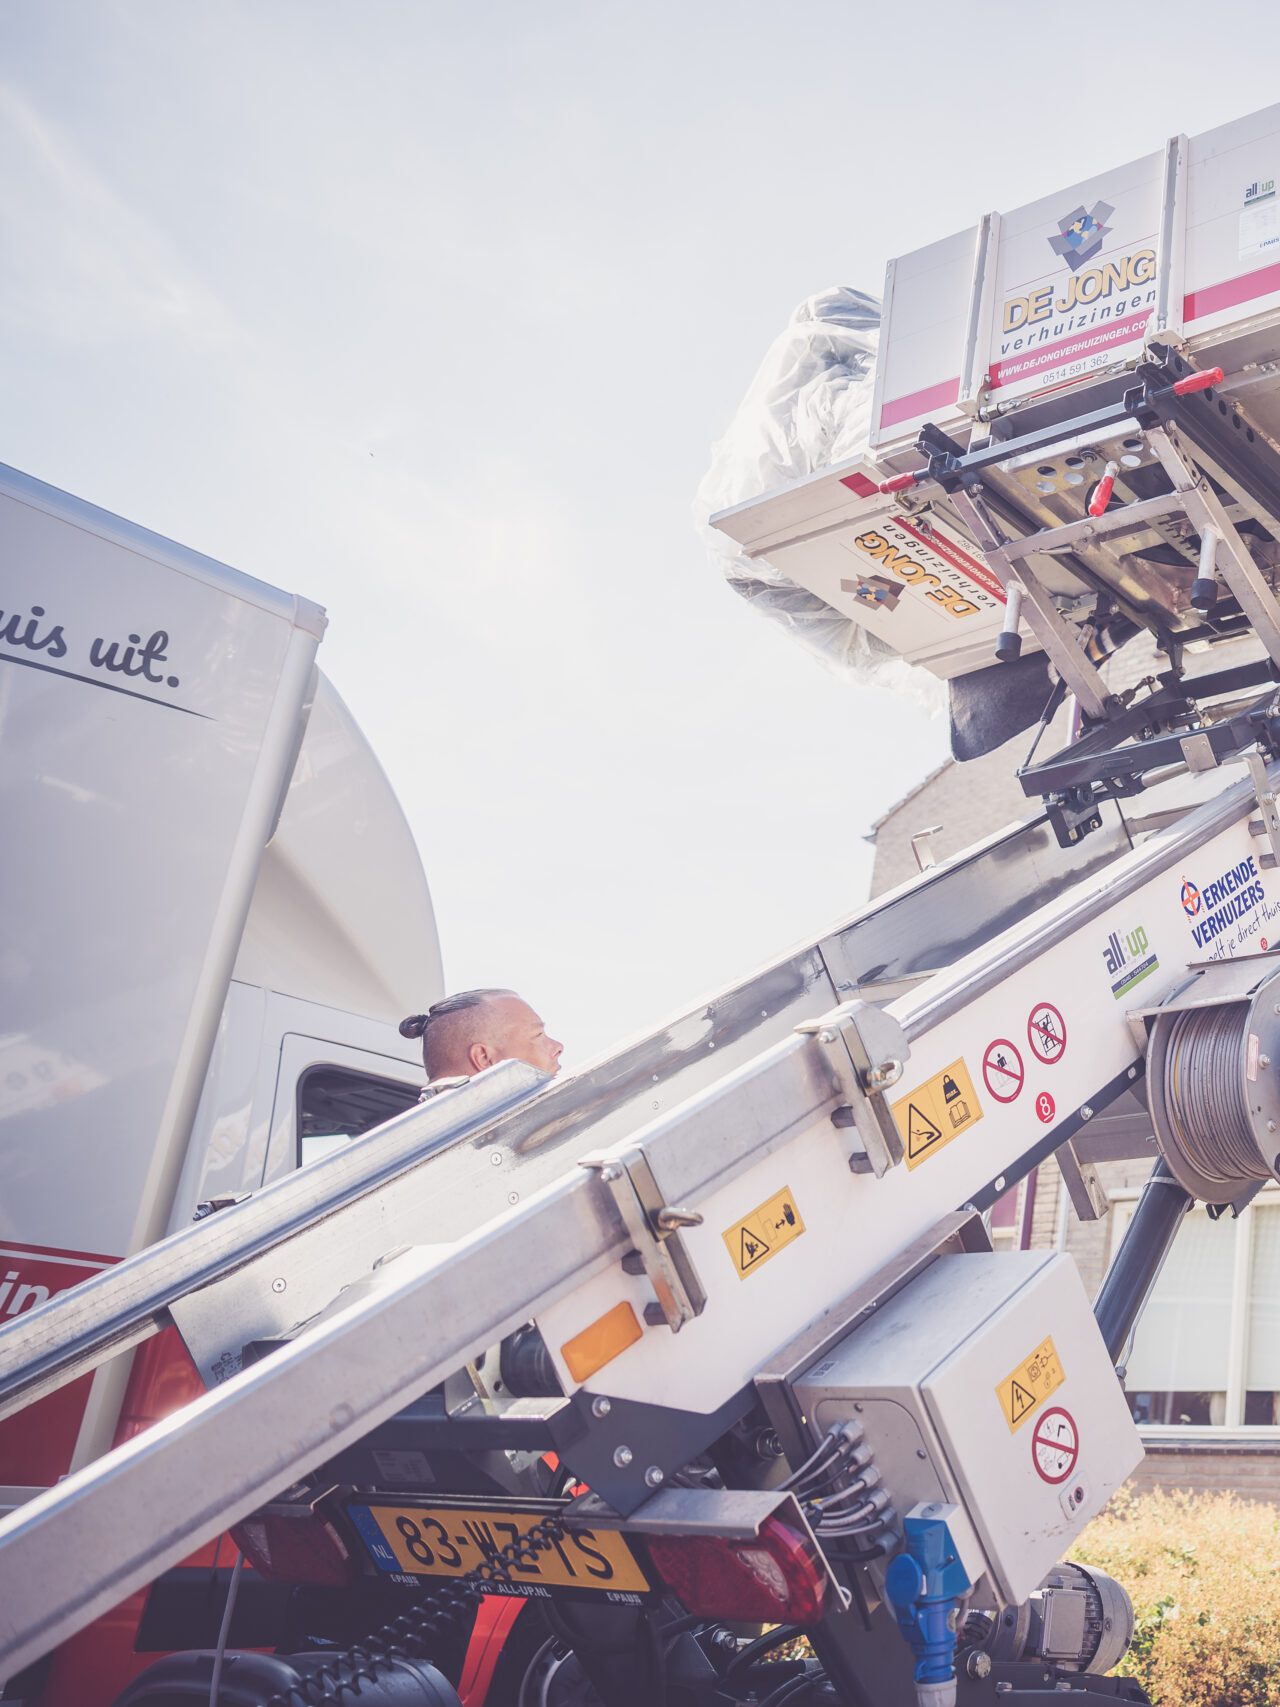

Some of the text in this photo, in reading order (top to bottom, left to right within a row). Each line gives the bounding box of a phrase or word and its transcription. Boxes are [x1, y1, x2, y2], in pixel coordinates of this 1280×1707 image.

[1003, 249, 1157, 334] DE JONG
[997, 319, 1149, 379] WWW.DEJONGVERHUIZINGEN.CO
[1001, 290, 1156, 355] verhuizingen
[1042, 353, 1109, 385] 0514 591 362
[855, 530, 981, 619] DE JONG
[882, 524, 997, 608] verhuizingen
[89, 630, 180, 688] uit.
[1202, 855, 1258, 910] ERKENDE
[1191, 880, 1265, 949] VERHUIZERS
[1237, 910, 1260, 943] direct
[1102, 932, 1126, 975] all
[1126, 926, 1149, 955] up
[1040, 1096, 1051, 1116] 8
[0, 1271, 70, 1315] in
[371, 1544, 393, 1559] NL
[396, 1515, 614, 1580] 83-WZTS
